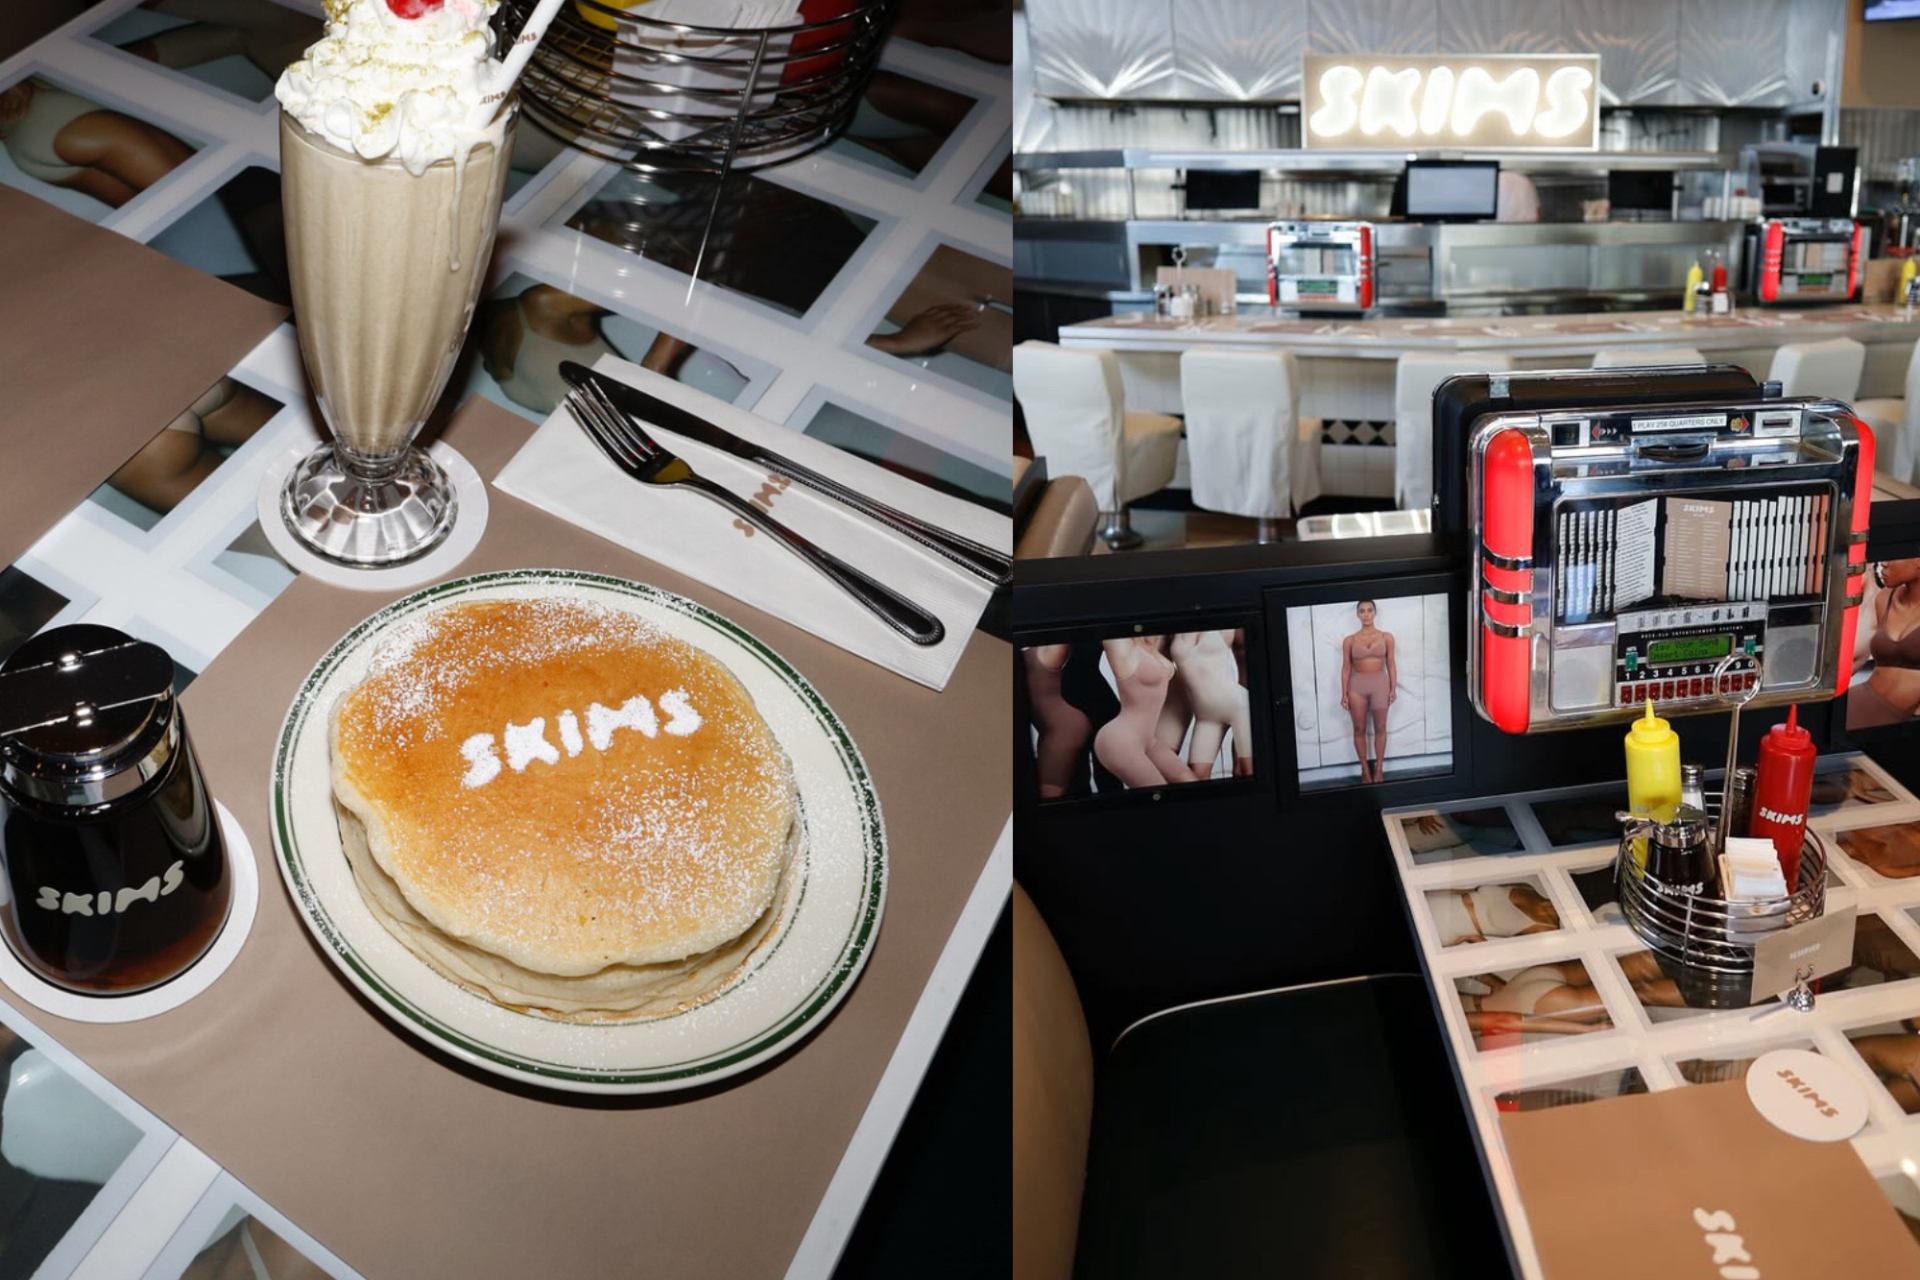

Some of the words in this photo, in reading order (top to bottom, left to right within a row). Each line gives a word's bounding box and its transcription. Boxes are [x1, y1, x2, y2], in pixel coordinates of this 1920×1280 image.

[1309, 65, 1594, 138] SKIMS
[1668, 418, 1706, 428] QUARTERS
[1706, 417, 1725, 426] ONLY
[1683, 504, 1715, 514] SKIMS
[1625, 672, 1631, 680] 1
[1639, 670, 1646, 679] 2
[1653, 669, 1659, 678] 3
[1667, 668, 1673, 676] 4
[1681, 667, 1688, 675] 5
[1694, 665, 1701, 674] 6
[1708, 664, 1715, 672] 7
[1735, 661, 1742, 669] 9
[458, 684, 704, 790] SKIMS
[1759, 806, 1804, 826] SKIMS
[35, 859, 185, 918] SKIMS
[1776, 1069, 1839, 1118] SKIMS
